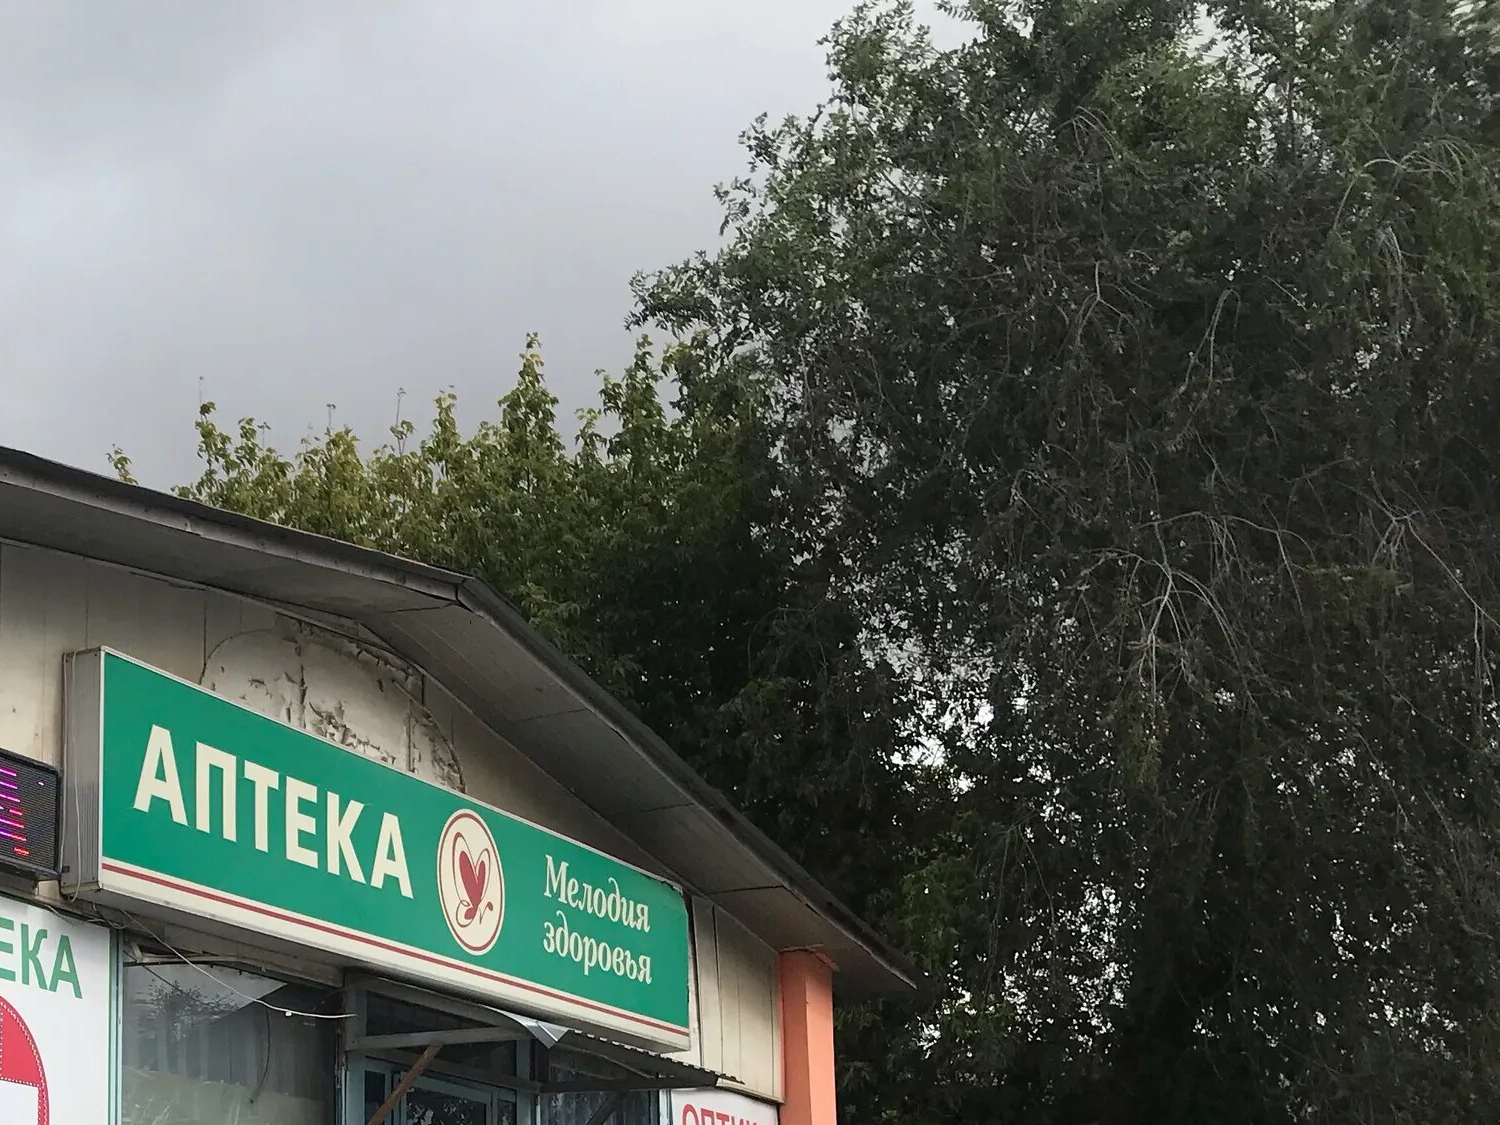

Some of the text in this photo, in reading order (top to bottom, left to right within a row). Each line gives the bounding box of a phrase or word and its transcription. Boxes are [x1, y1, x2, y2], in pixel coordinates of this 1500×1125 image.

[133, 724, 414, 899] АПТЕКА
[543, 854, 650, 933] Мелодия
[543, 910, 652, 984] здоровья
